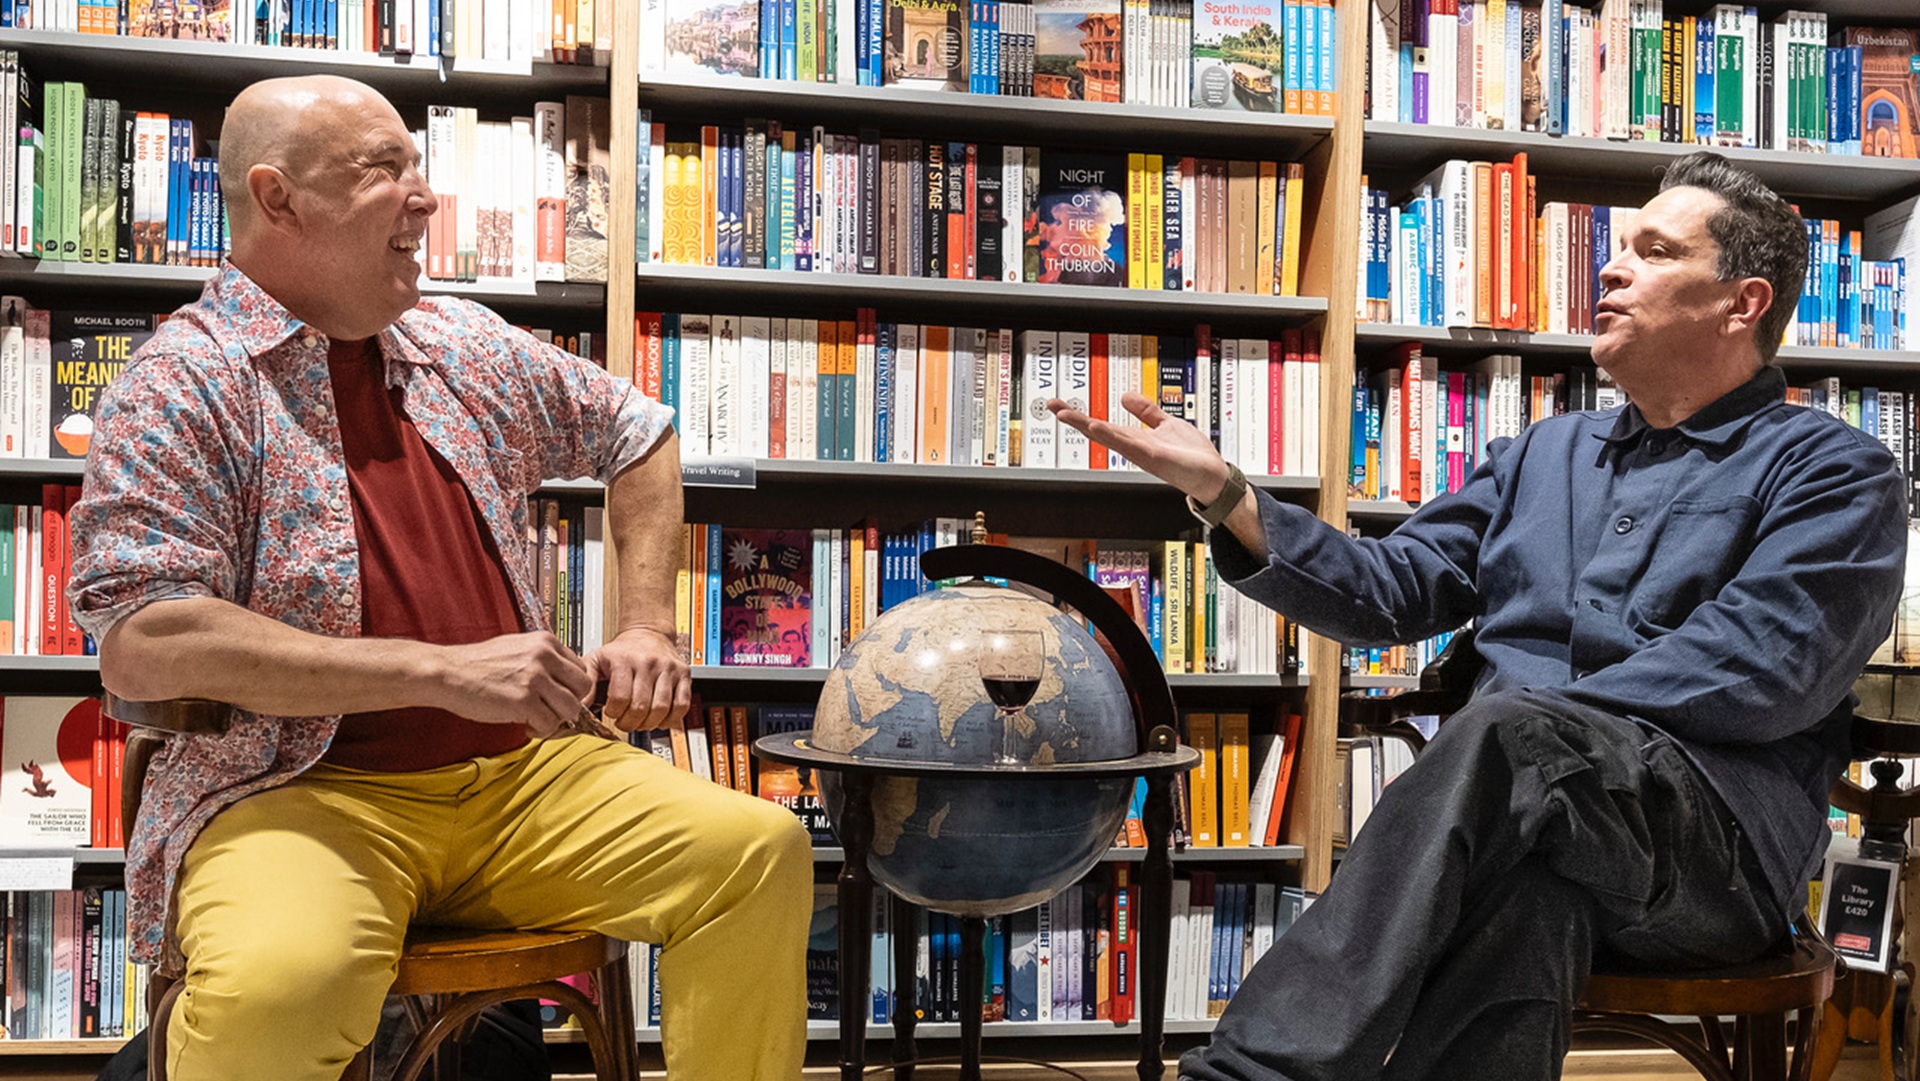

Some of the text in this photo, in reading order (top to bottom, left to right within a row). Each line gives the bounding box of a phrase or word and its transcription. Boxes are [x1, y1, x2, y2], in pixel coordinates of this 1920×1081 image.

[932, 2, 957, 12] Agra
[1204, 2, 1271, 16] South India
[1212, 15, 1220, 26] &
[870, 7, 882, 55] HIMALAYA
[1522, 11, 1532, 63] NAPOLEON
[1732, 10, 1743, 71] Bradt Mongolia
[1857, 34, 1910, 47] Uzbekistan
[971, 28, 980, 74] RAJASTHAN
[981, 29, 989, 76] RAJASTHAN
[990, 30, 998, 76] RAJASTHAN
[1634, 31, 1644, 71] Kazakhstan
[1695, 41, 1705, 74] Mongolia
[1704, 42, 1714, 75] Mongolia
[1719, 38, 1730, 70] Mongolia
[1762, 42, 1773, 86] VIOLET
[138, 134, 150, 161] Kyoto
[154, 135, 166, 161] Kyoto
[755, 148, 764, 171] LIGHT
[48, 159, 58, 182] KYOTO
[67, 160, 76, 183] KYOTO
[120, 162, 132, 189] Kyoto
[746, 145, 754, 202] OF THE WORLD
[865, 158, 874, 189] WIDOWS
[928, 145, 943, 210] HOT STAGE
[1059, 169, 1105, 184] NIGHT
[755, 184, 764, 197] THE
[1072, 194, 1092, 208] OF
[780, 177, 796, 255] AFTERLIVES
[865, 201, 874, 235] MALABAR
[1149, 205, 1159, 229] THRITY
[1502, 175, 1510, 234] THE DEAD SEA
[931, 213, 939, 234] ANITA
[1069, 218, 1094, 233] FIRE
[1165, 218, 1180, 240] SEA
[1480, 173, 1490, 270] THE HOUSE DIVIDED
[1059, 243, 1104, 257] COLIN
[1149, 230, 1159, 264] UMRIGAR
[1377, 213, 1387, 263] Middle East
[1047, 258, 1116, 274] THUBRON
[1408, 233, 1418, 315] ARABIC ENGLISH
[1436, 263, 1444, 282] EAST
[74, 317, 146, 327] MICHAEL BOOTH
[95, 335, 133, 360] THE
[648, 321, 659, 394] SHADOWS AT
[56, 361, 126, 386] MEANI
[878, 331, 889, 415] COURTING INDIA
[999, 335, 1010, 407] HISTORY'S ANGEL
[1038, 341, 1054, 389] INDIA
[1072, 341, 1088, 390] INDIA
[71, 386, 96, 411] OF
[1356, 391, 1366, 412] Iran
[1408, 349, 1422, 461] WHAT IRANIANS WANT
[716, 382, 729, 445] ANARCHY
[1370, 404, 1380, 438] IRAN
[1878, 394, 1889, 436] SHALASH
[1892, 395, 1902, 455] SHALASH THE
[681, 465, 741, 479] Travel Writing
[543, 551, 551, 570] LOVE
[760, 554, 769, 570] A
[46, 574, 57, 622] QUESTION
[726, 573, 804, 600] BOLLYWOOD
[1169, 549, 1179, 645] WILDLIFE SRI LANKA
[744, 595, 782, 610] STATE
[853, 586, 861, 620] ELEANOR
[1152, 603, 1160, 639] SRI LANKA
[1288, 623, 1297, 648] Taseer
[734, 653, 792, 665] SUNNY SINGH
[773, 795, 799, 809] THE
[1841, 895, 1875, 908] Library
[1851, 885, 1869, 895] The
[1845, 906, 1868, 917] £420
